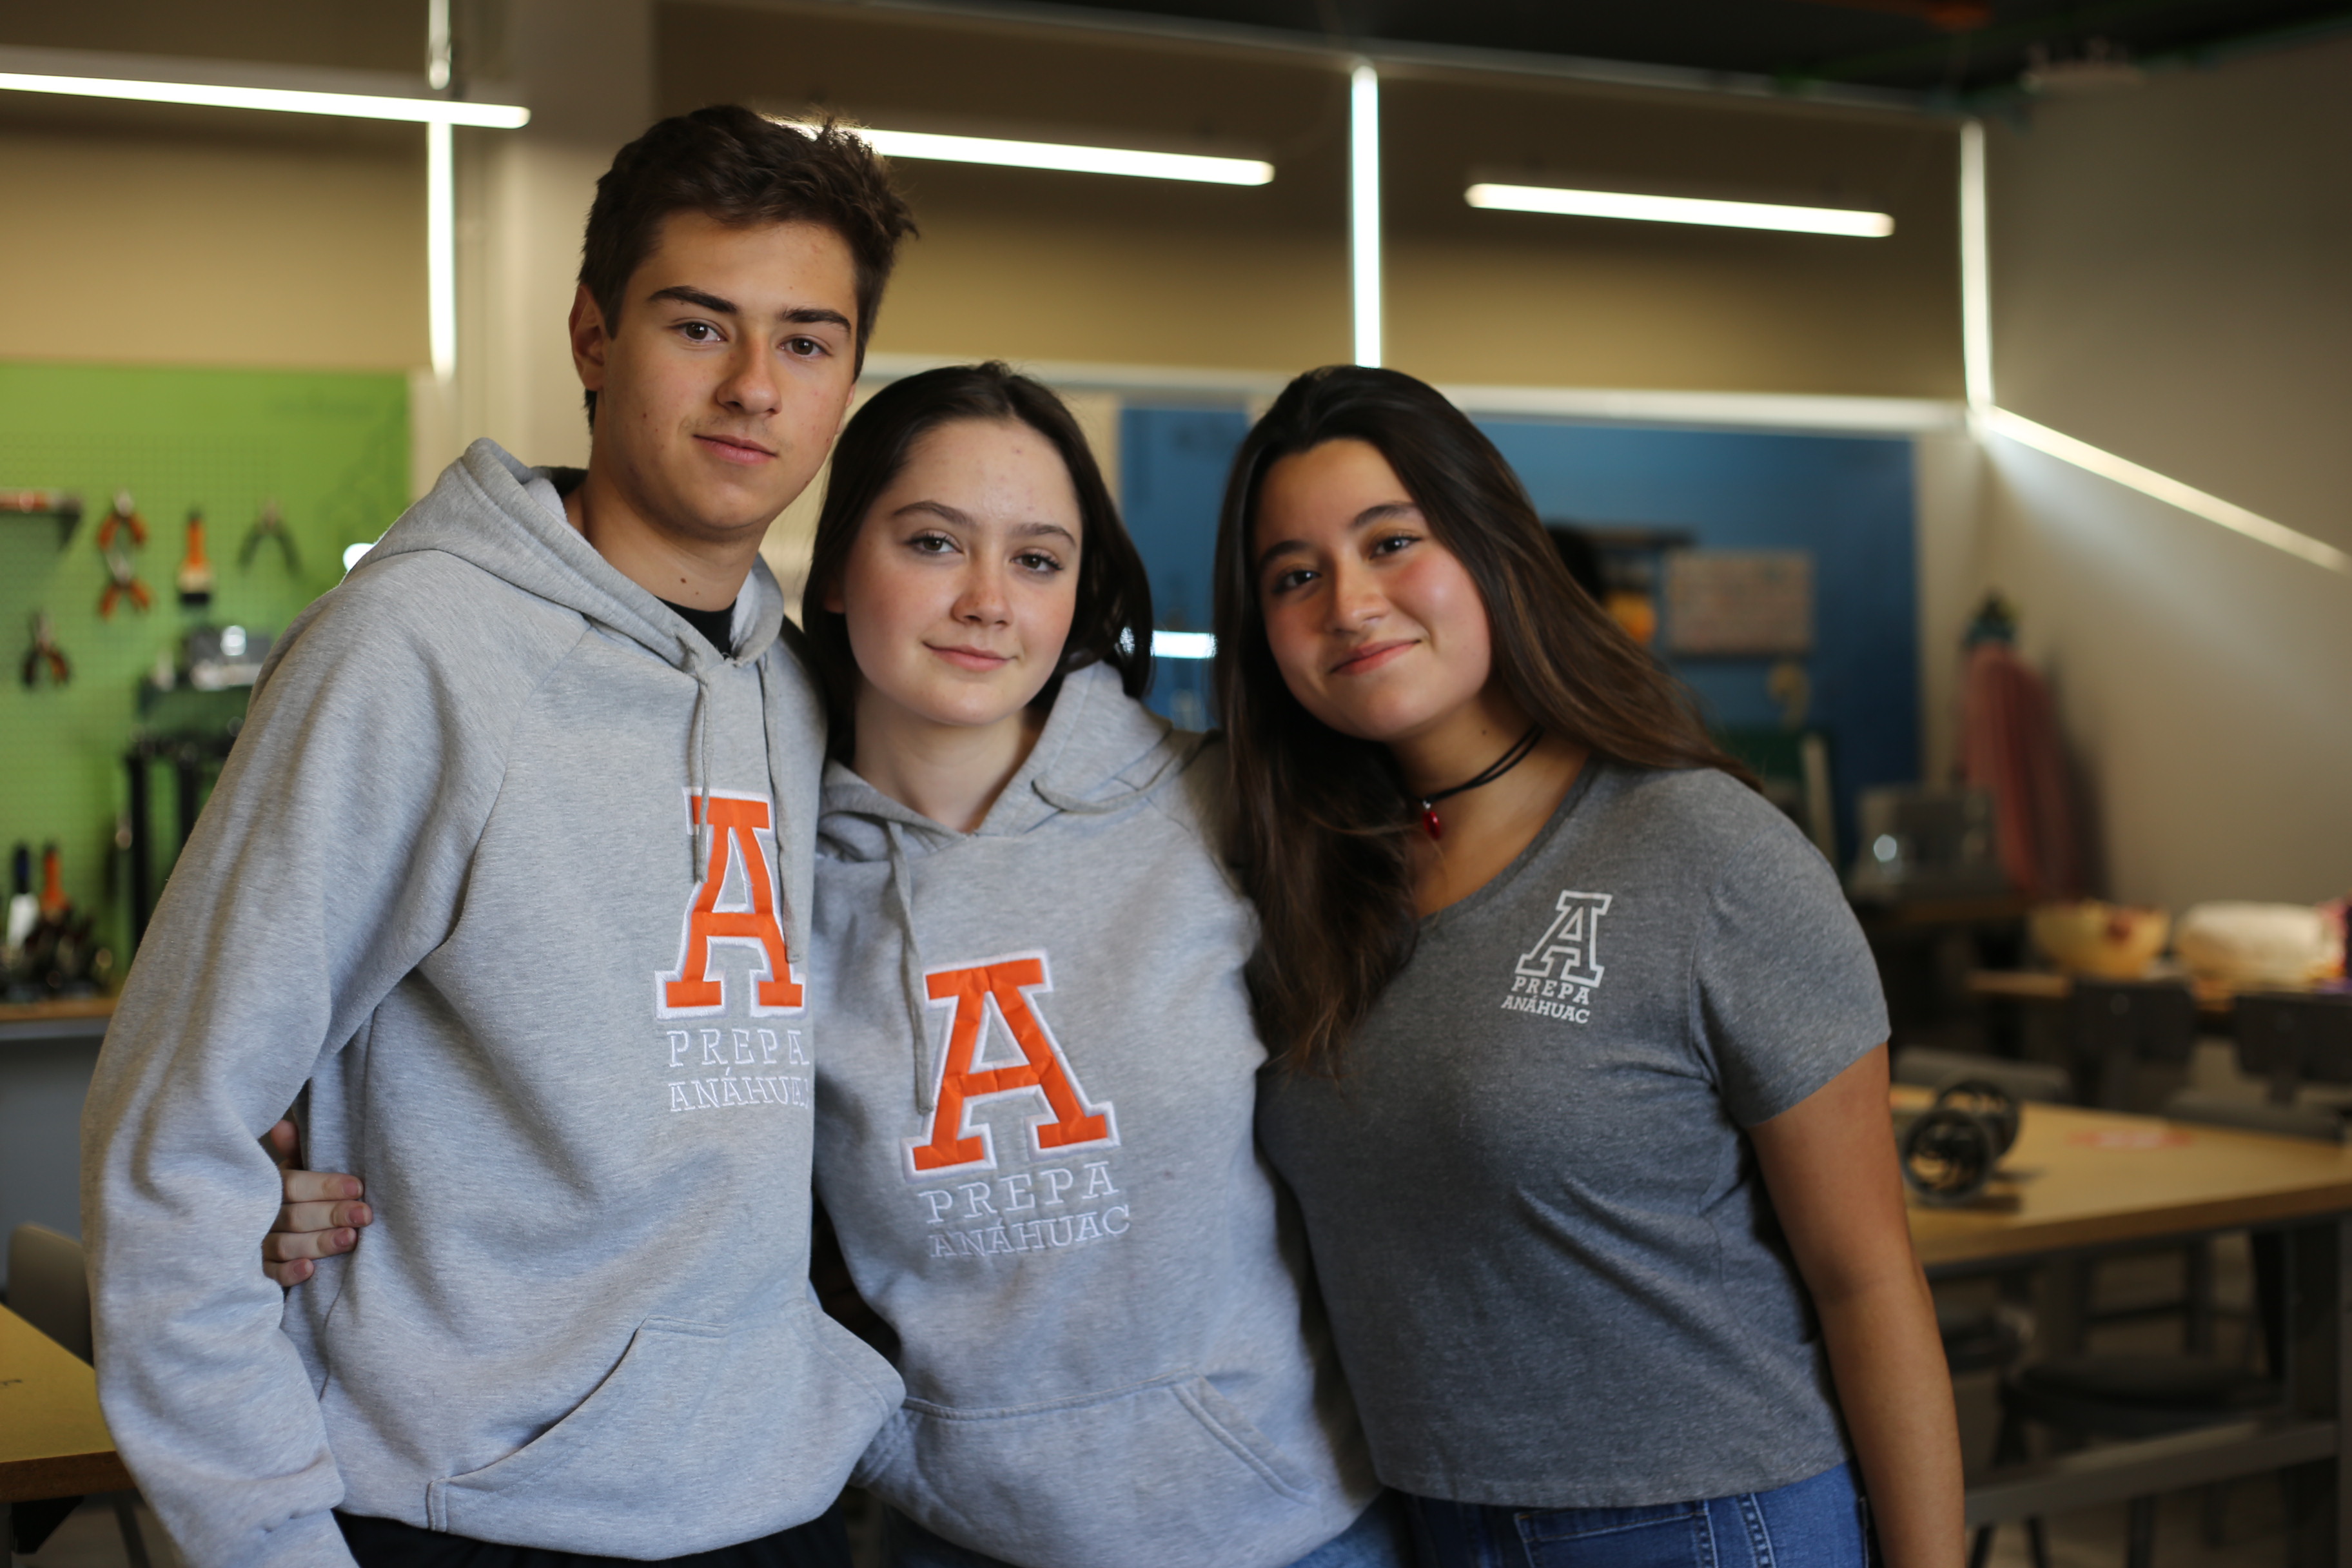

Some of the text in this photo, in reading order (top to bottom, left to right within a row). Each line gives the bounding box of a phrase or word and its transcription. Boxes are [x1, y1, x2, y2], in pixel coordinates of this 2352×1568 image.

[654, 787, 807, 1020] A
[1515, 889, 1612, 988] A
[1501, 994, 1591, 1024] ANÁHUAC
[1511, 975, 1591, 1005] PREPA
[667, 1028, 810, 1067] PREPA
[902, 948, 1121, 1182] A
[918, 1161, 1119, 1224] PREPA
[928, 1204, 1130, 1258] ANÁHUAC
